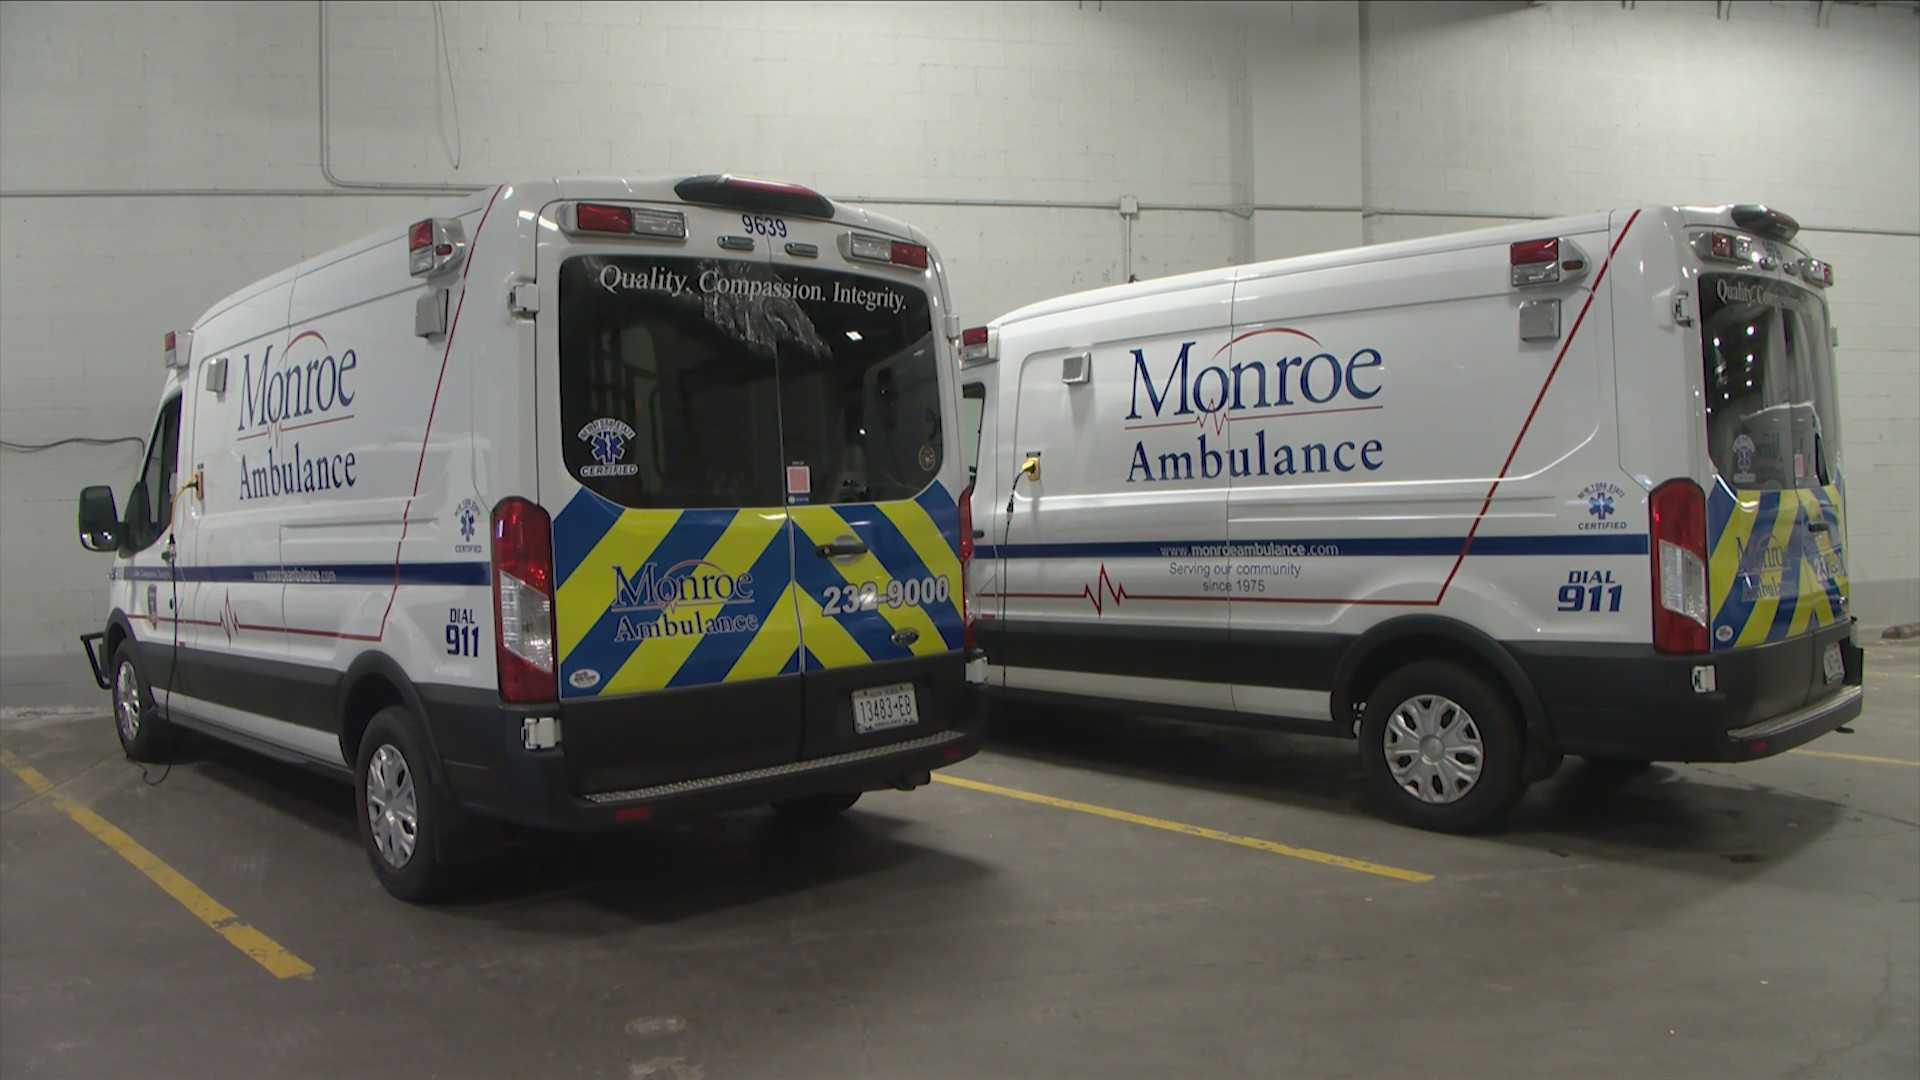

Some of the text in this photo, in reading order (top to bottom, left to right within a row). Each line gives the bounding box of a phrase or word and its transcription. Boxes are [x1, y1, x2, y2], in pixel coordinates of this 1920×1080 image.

[742, 214, 787, 237] 9639
[600, 264, 907, 314] Quality. Compassion. Integrity.
[238, 344, 357, 431] Monroe
[1125, 341, 1382, 420] Monroe
[1126, 429, 1384, 482] Ambulance
[239, 441, 357, 500] Ambulance
[581, 465, 638, 476] CERTIFIED
[1578, 521, 1627, 530] CERTIFIED
[1160, 542, 1339, 557] www.monroeambulance.com
[611, 562, 754, 607] Monroe
[1169, 562, 1301, 578] Serving our community
[1568, 570, 1615, 584] DIAL
[821, 576, 950, 617] 232-9000
[1203, 579, 1265, 592] since 1975
[1557, 585, 1622, 612] 911
[450, 608, 475, 625] DIAL
[614, 611, 760, 643] Ambulance
[446, 625, 479, 658] 911
